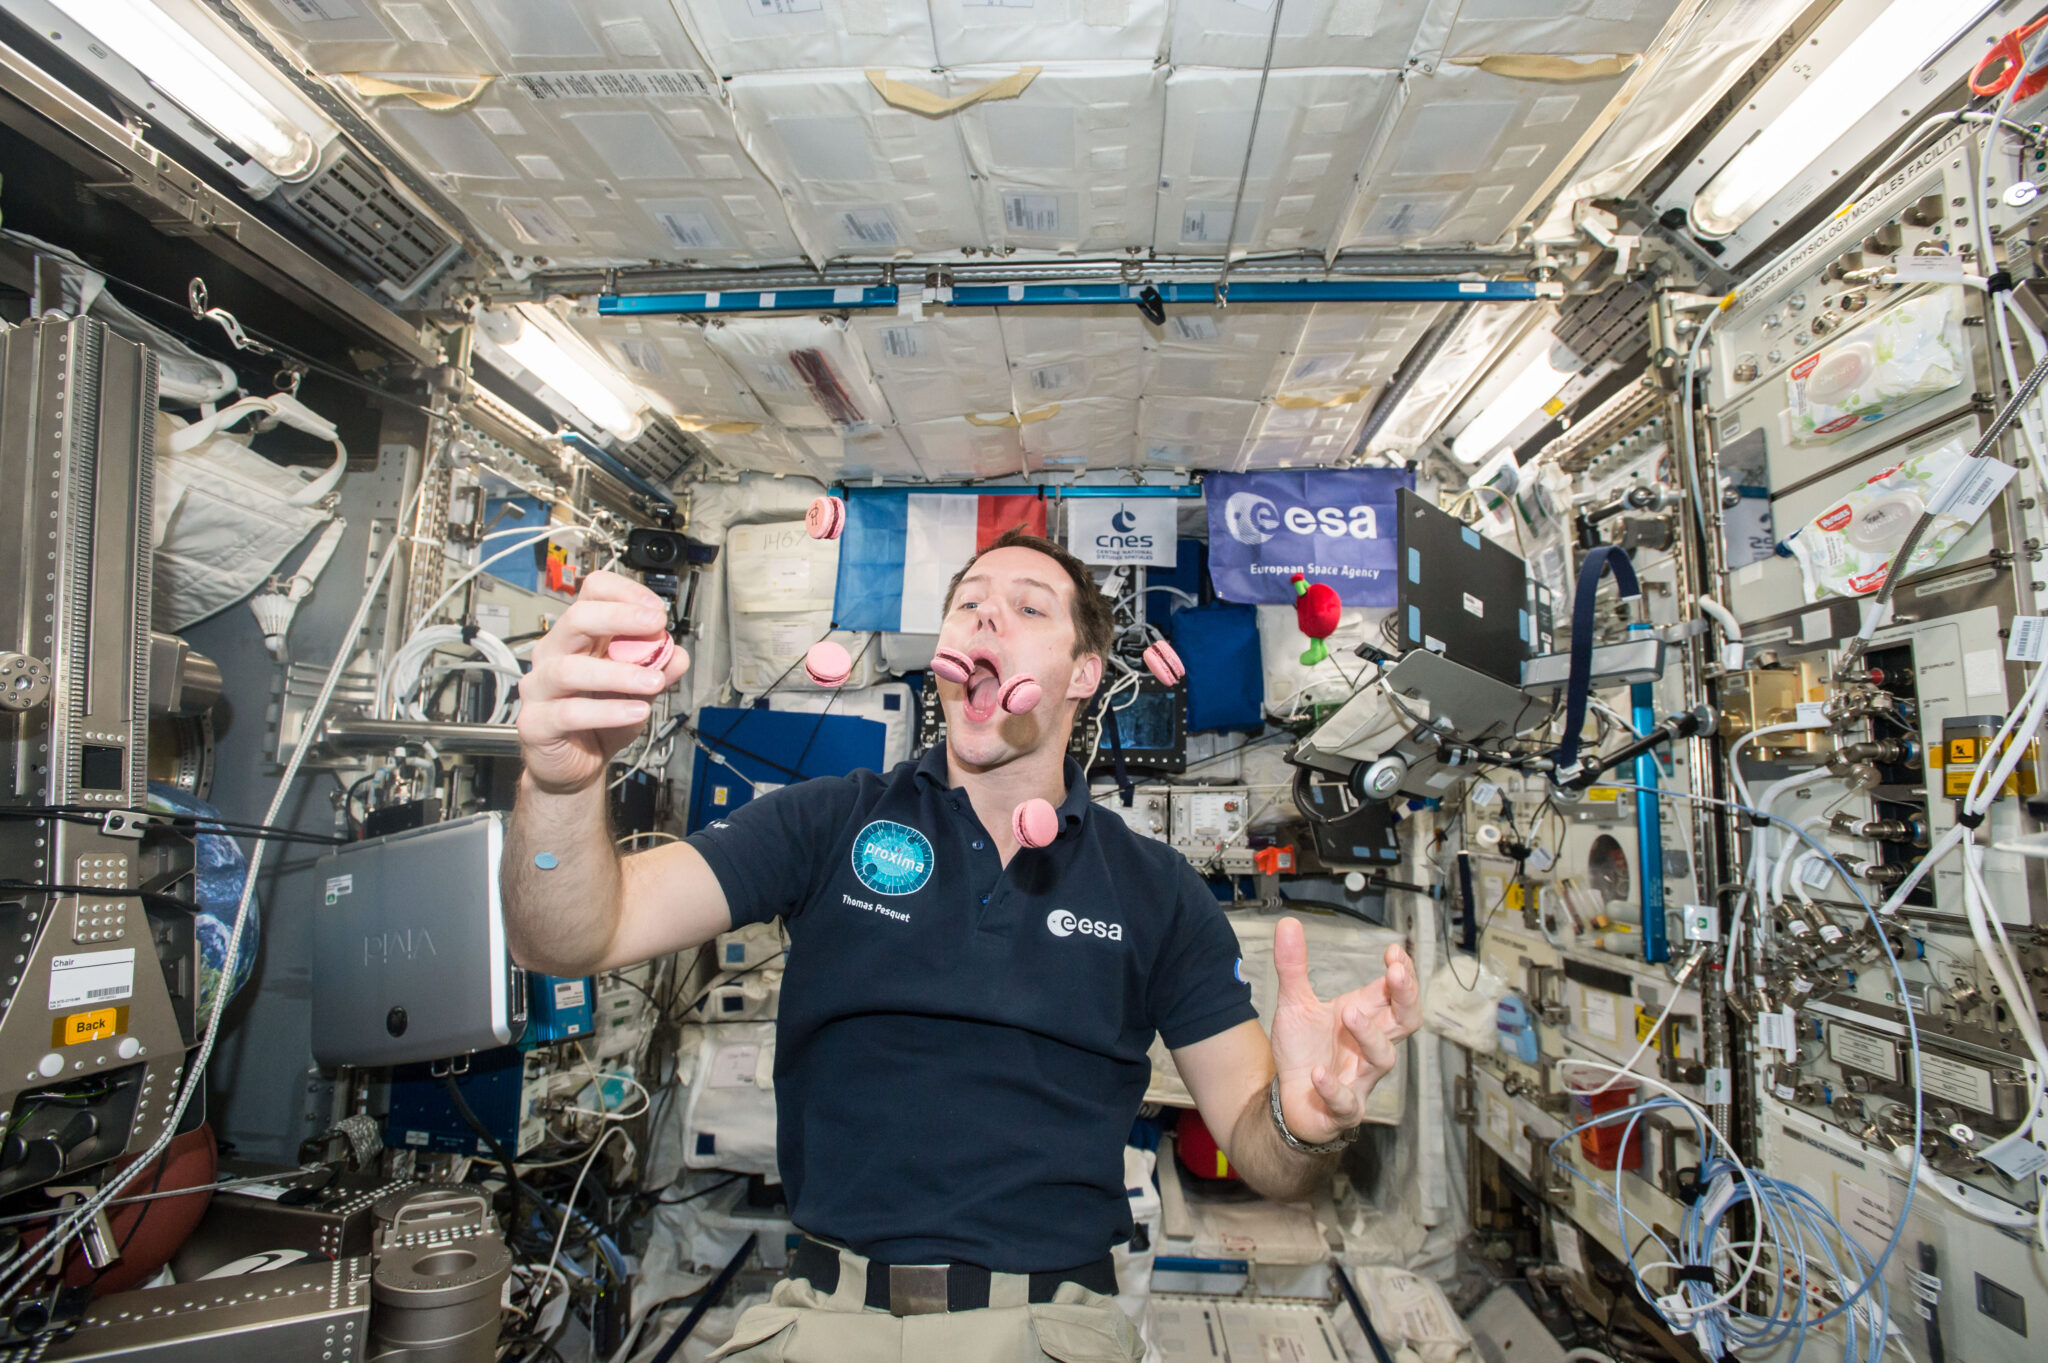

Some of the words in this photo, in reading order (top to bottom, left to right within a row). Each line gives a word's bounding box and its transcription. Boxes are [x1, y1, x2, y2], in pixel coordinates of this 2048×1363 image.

[1744, 264, 1789, 303] EUROPEAN
[1790, 216, 1849, 268] PHYSIOLOGY
[1852, 173, 1905, 218] MODULES
[1907, 130, 1962, 178] FACILITY
[1284, 505, 1378, 539] esa
[1096, 535, 1153, 548] cnes
[1250, 563, 1304, 574] European
[1307, 562, 1338, 576] Space
[1341, 565, 1380, 580] Agency
[863, 842, 925, 874] proxima
[842, 894, 874, 911] Thomas
[875, 903, 911, 923] Pesquet
[1077, 917, 1123, 942] esa
[364, 927, 437, 967] Vivid
[53, 959, 75, 968] Chair
[76, 1018, 106, 1033] Back
[1829, 1147, 1866, 1171] CONTAINER
